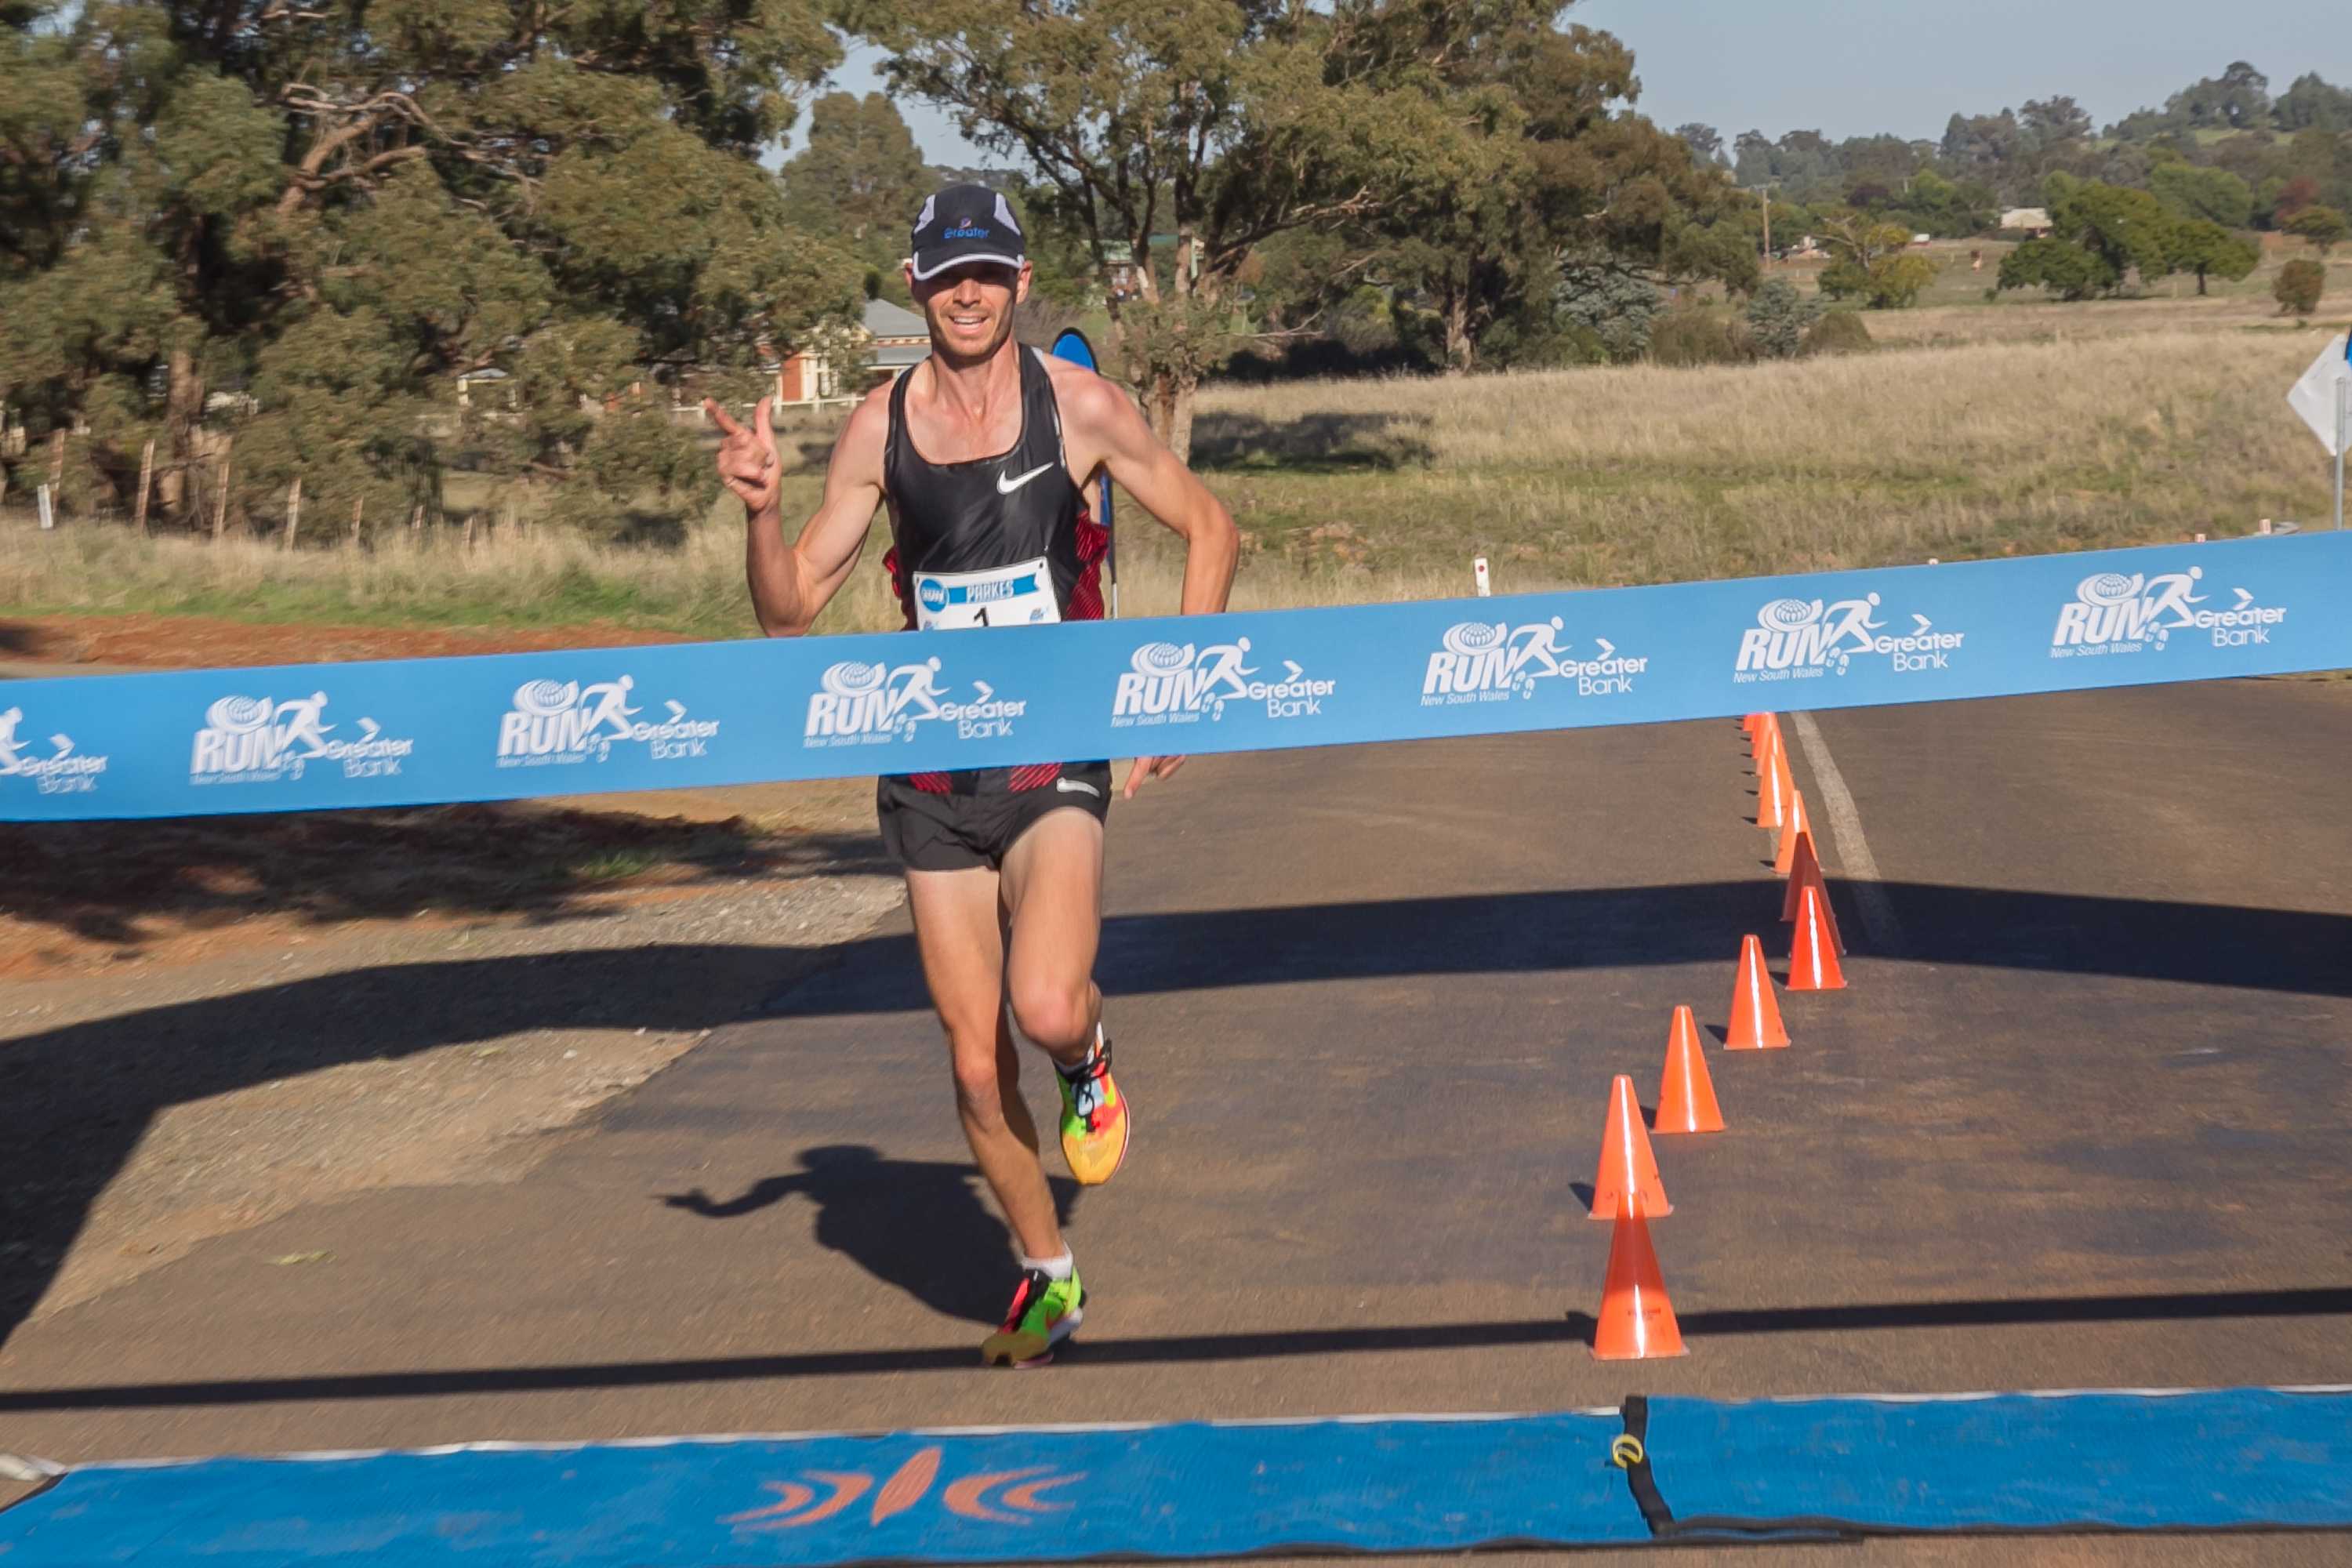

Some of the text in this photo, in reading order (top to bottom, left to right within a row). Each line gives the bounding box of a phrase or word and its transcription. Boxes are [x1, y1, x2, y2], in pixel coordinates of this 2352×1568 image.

[966, 579, 1014, 604] PARKES
[2053, 597, 2156, 646] RUN
[2194, 607, 2287, 628] Greater
[1736, 622, 1835, 671] RUN
[1875, 633, 1965, 654] Greater
[2212, 626, 2271, 648] Bank
[1893, 651, 1948, 672] Bank
[2051, 642, 2142, 659] New South Wales
[1423, 647, 1519, 694] RUN
[1559, 657, 1648, 678] Greater
[1733, 667, 1824, 684] New South Wales
[1112, 667, 1208, 716] RUN
[1247, 679, 1335, 700] Greater
[1578, 674, 1633, 696] Bank
[1266, 697, 1322, 718] Bank
[1421, 690, 1510, 706] New South Wales
[804, 688, 899, 737] RUN
[939, 700, 1026, 721] Greater
[496, 707, 593, 757] RUN
[631, 720, 719, 742] Greater
[957, 717, 1014, 739] Bank
[190, 724, 287, 775] RUN
[650, 739, 707, 760] Bank
